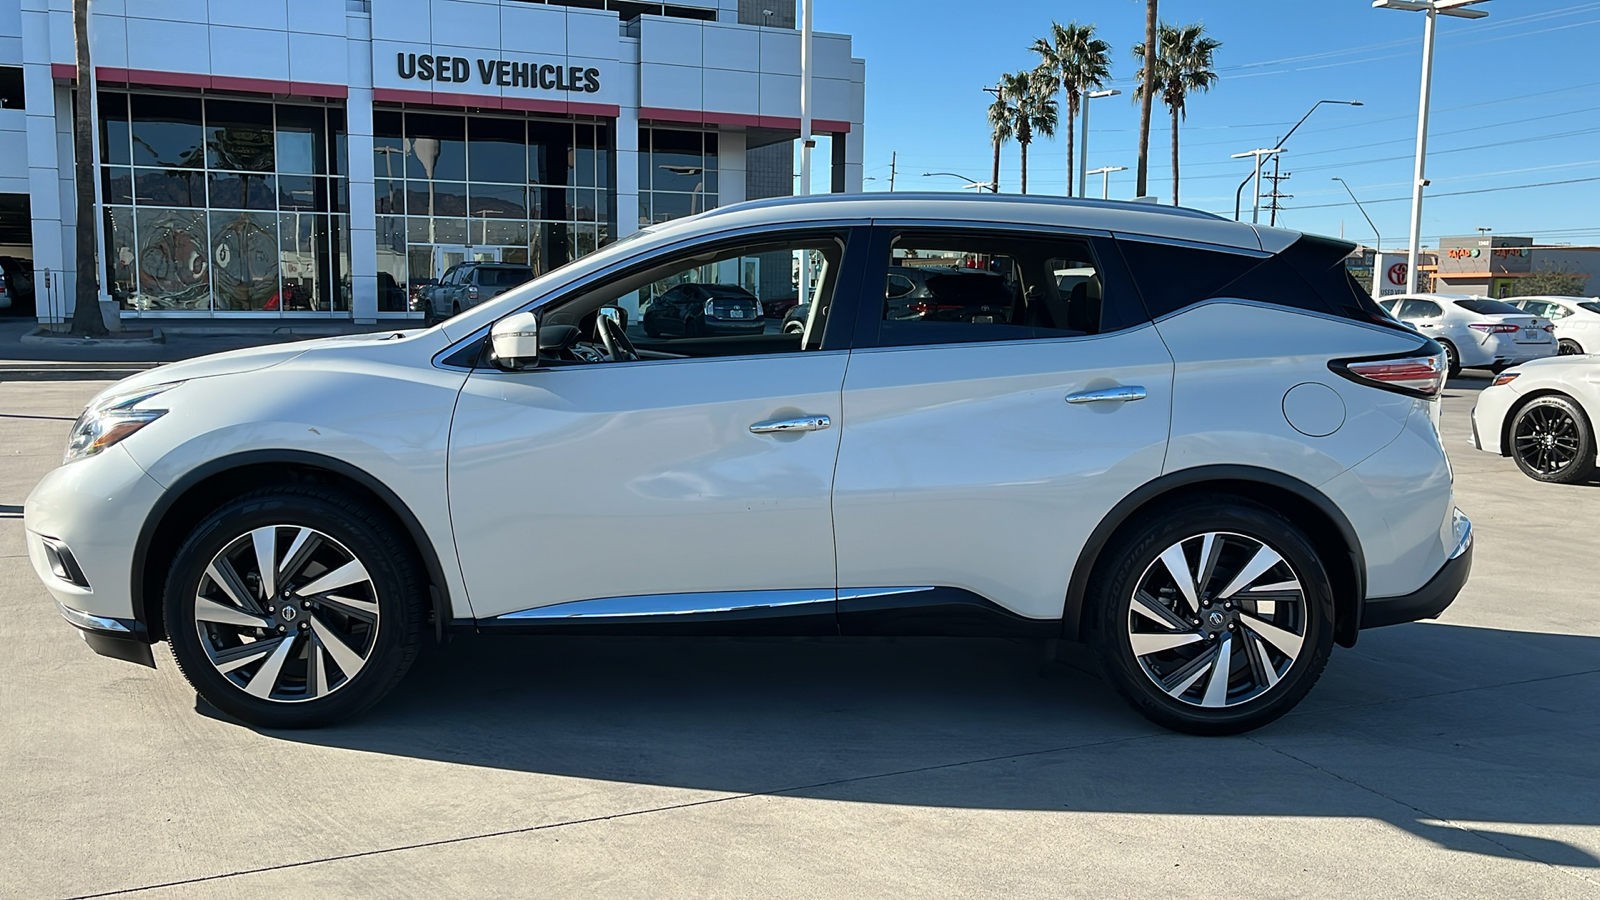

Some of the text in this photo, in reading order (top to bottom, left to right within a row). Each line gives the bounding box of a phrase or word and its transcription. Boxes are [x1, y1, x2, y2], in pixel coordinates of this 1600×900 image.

[398, 53, 600, 93] USED VEHICLES
[1107, 534, 1156, 619] SCORPION
